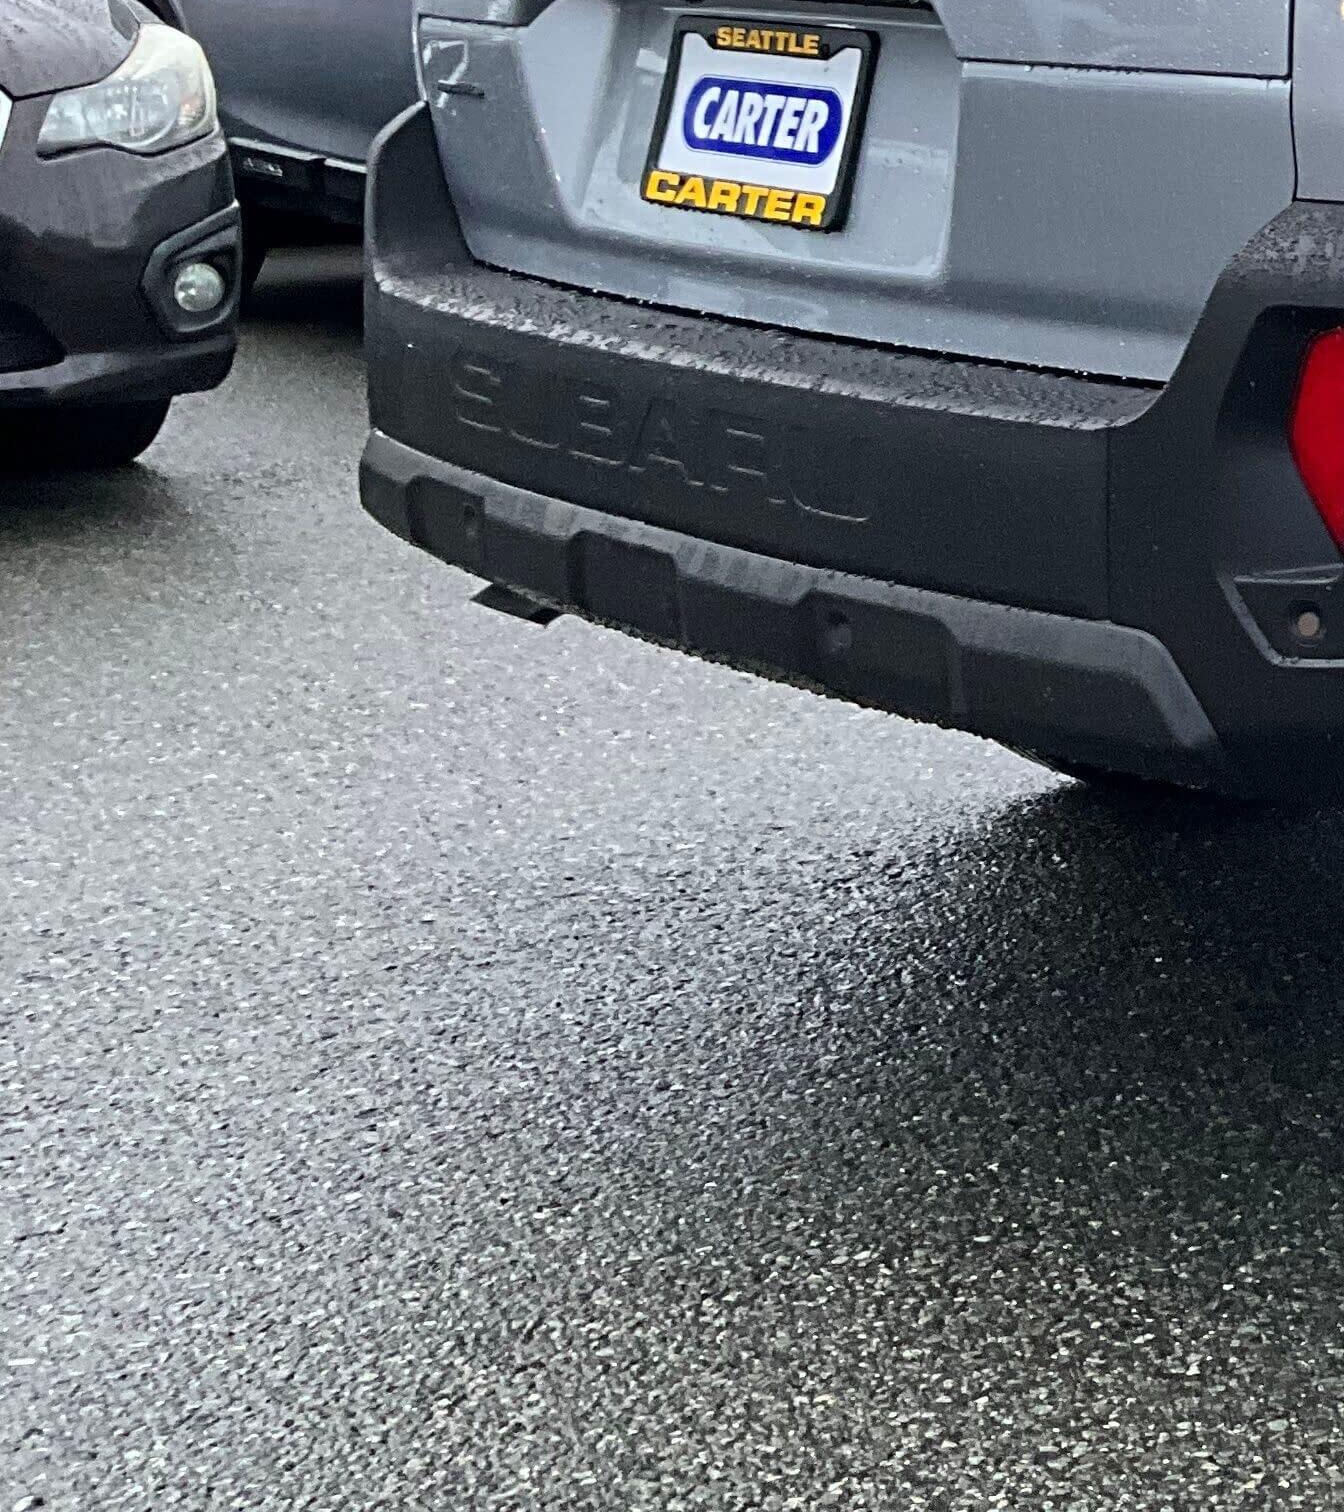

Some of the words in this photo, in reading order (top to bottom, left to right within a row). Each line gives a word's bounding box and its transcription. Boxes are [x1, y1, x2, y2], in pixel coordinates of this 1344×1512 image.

[715, 26, 821, 55] SEATTLE
[693, 86, 830, 154] CARTER
[645, 170, 827, 226] CARTER
